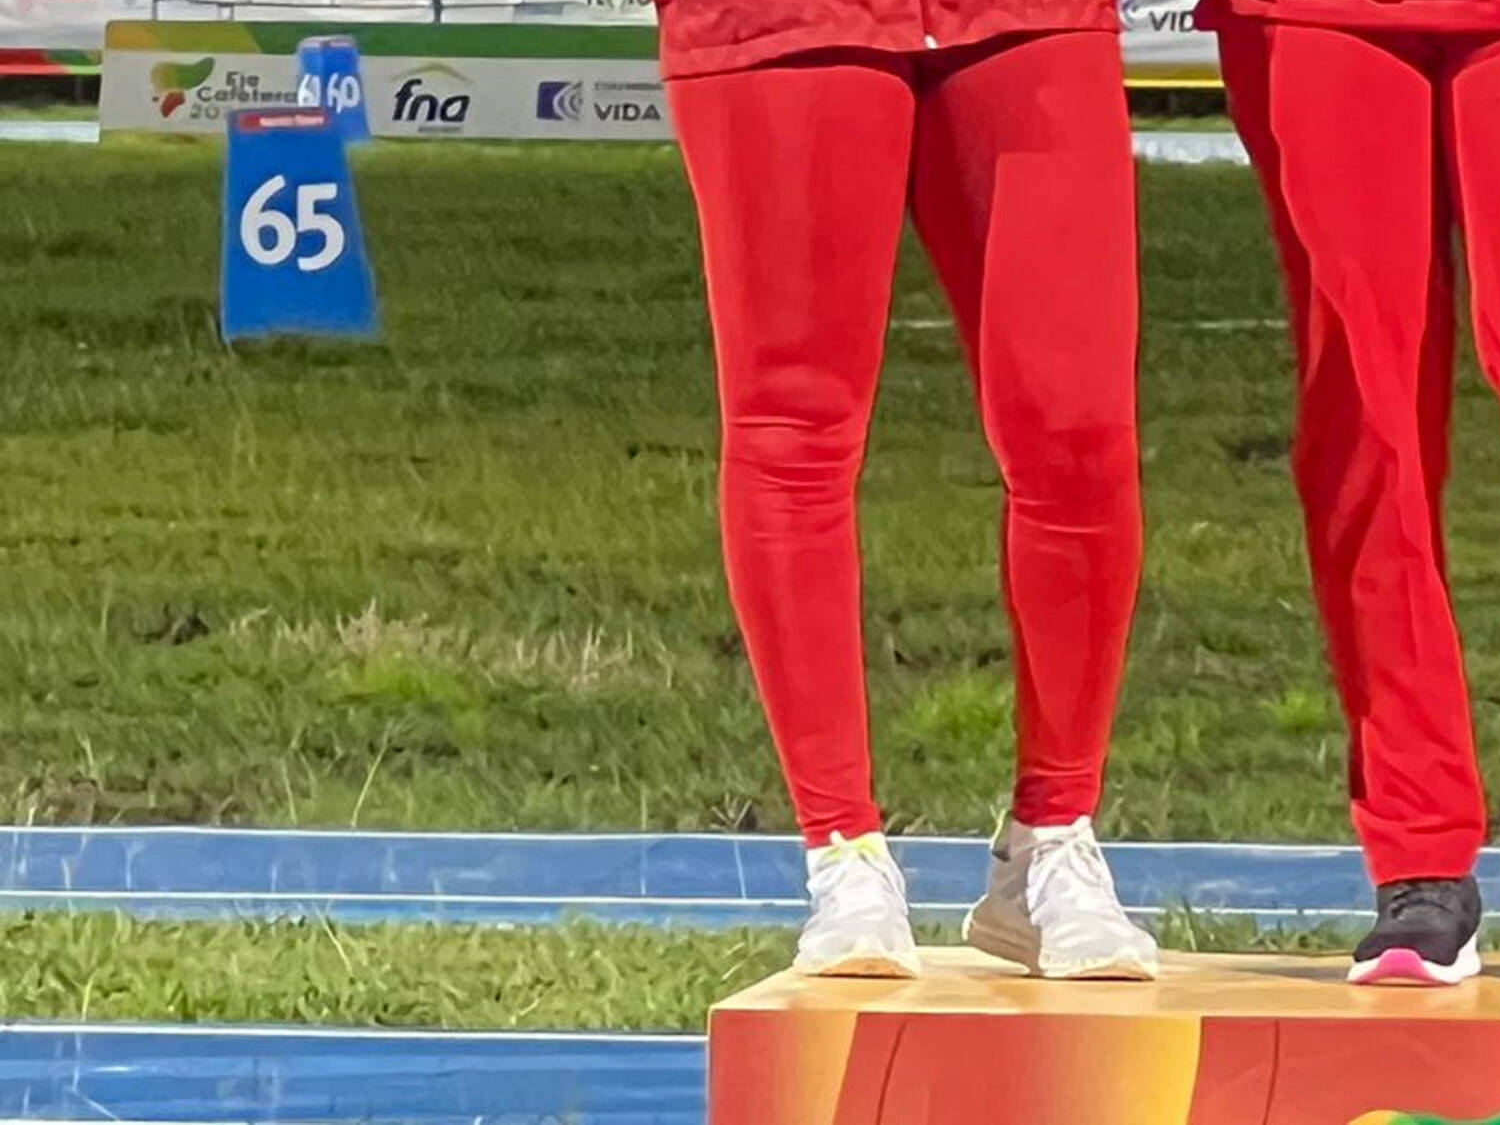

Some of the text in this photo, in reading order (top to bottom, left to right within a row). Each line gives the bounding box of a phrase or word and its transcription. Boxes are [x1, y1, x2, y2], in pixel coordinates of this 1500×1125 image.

[1149, 11, 1195, 32] VID
[392, 78, 471, 123] fna
[594, 102, 662, 122] VIDA
[240, 175, 345, 271] 65
